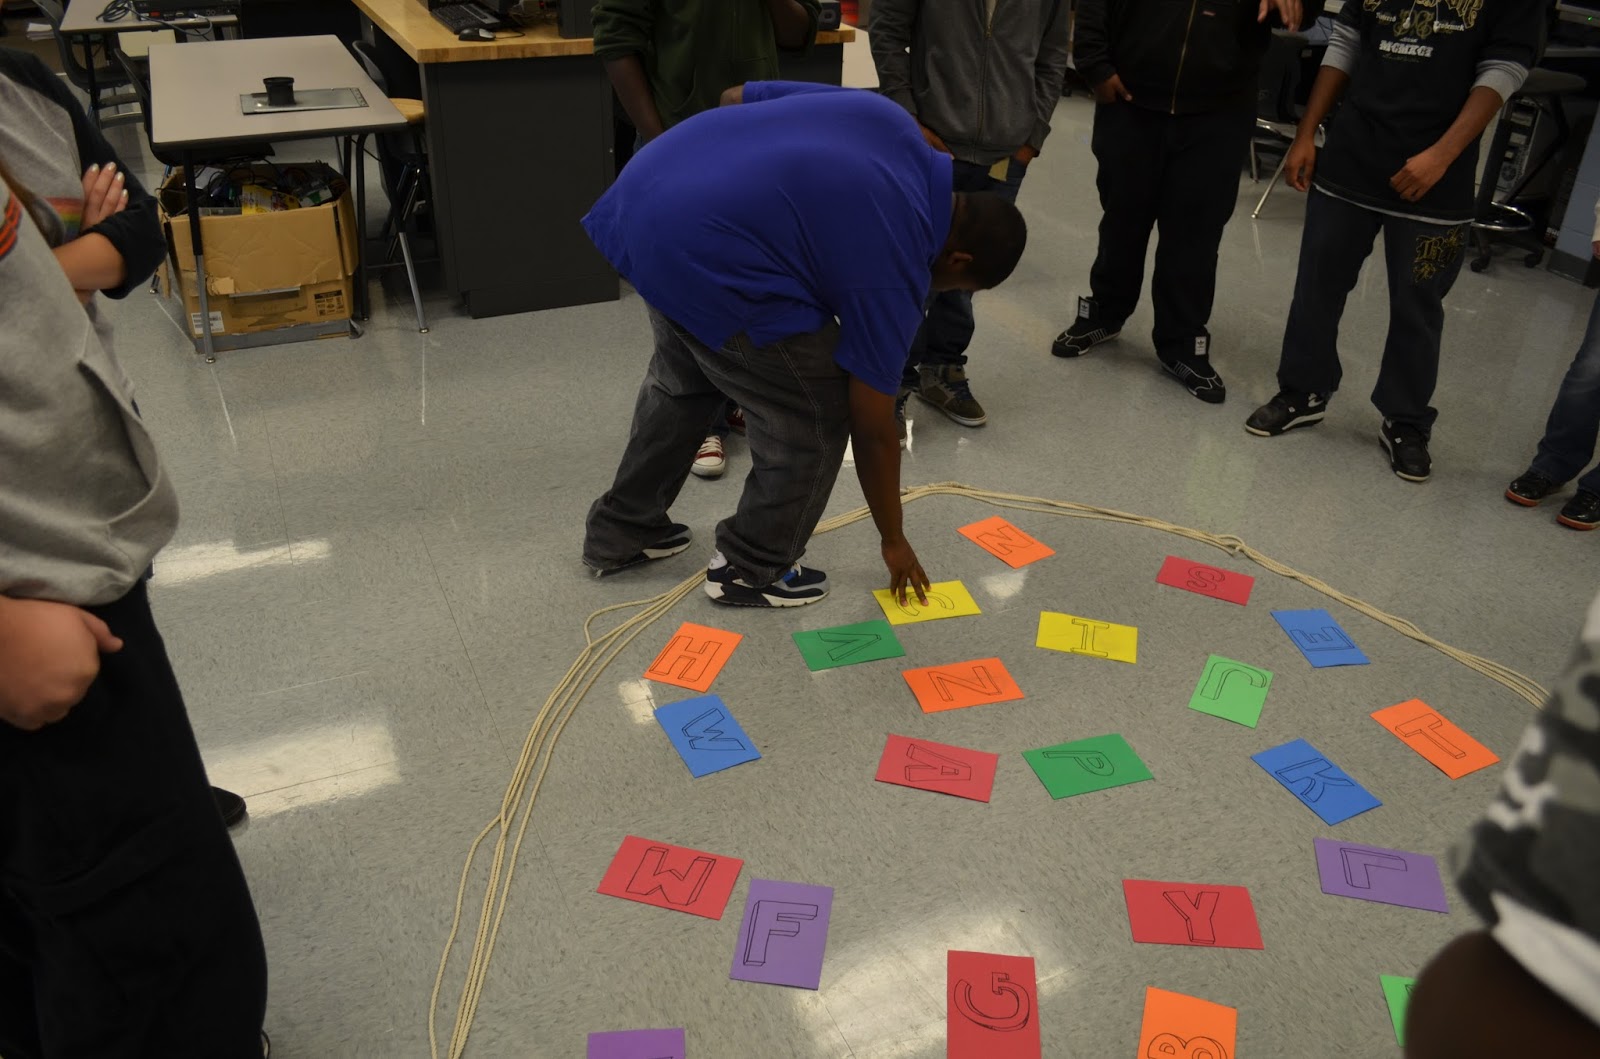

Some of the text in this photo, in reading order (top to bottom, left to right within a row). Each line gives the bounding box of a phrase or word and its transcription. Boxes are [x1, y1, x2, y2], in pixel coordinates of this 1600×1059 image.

[1187, 566, 1225, 592] S
[649, 635, 723, 682] H
[1070, 618, 1110, 658] I
[1289, 626, 1355, 652] E
[1200, 661, 1267, 701] J
[1394, 713, 1466, 760] T
[904, 743, 972, 781] A
[1042, 751, 1115, 777] P
[1275, 758, 1355, 803] K
[743, 900, 818, 966] F
[1162, 891, 1220, 944] Y
[954, 971, 1030, 1032] G
